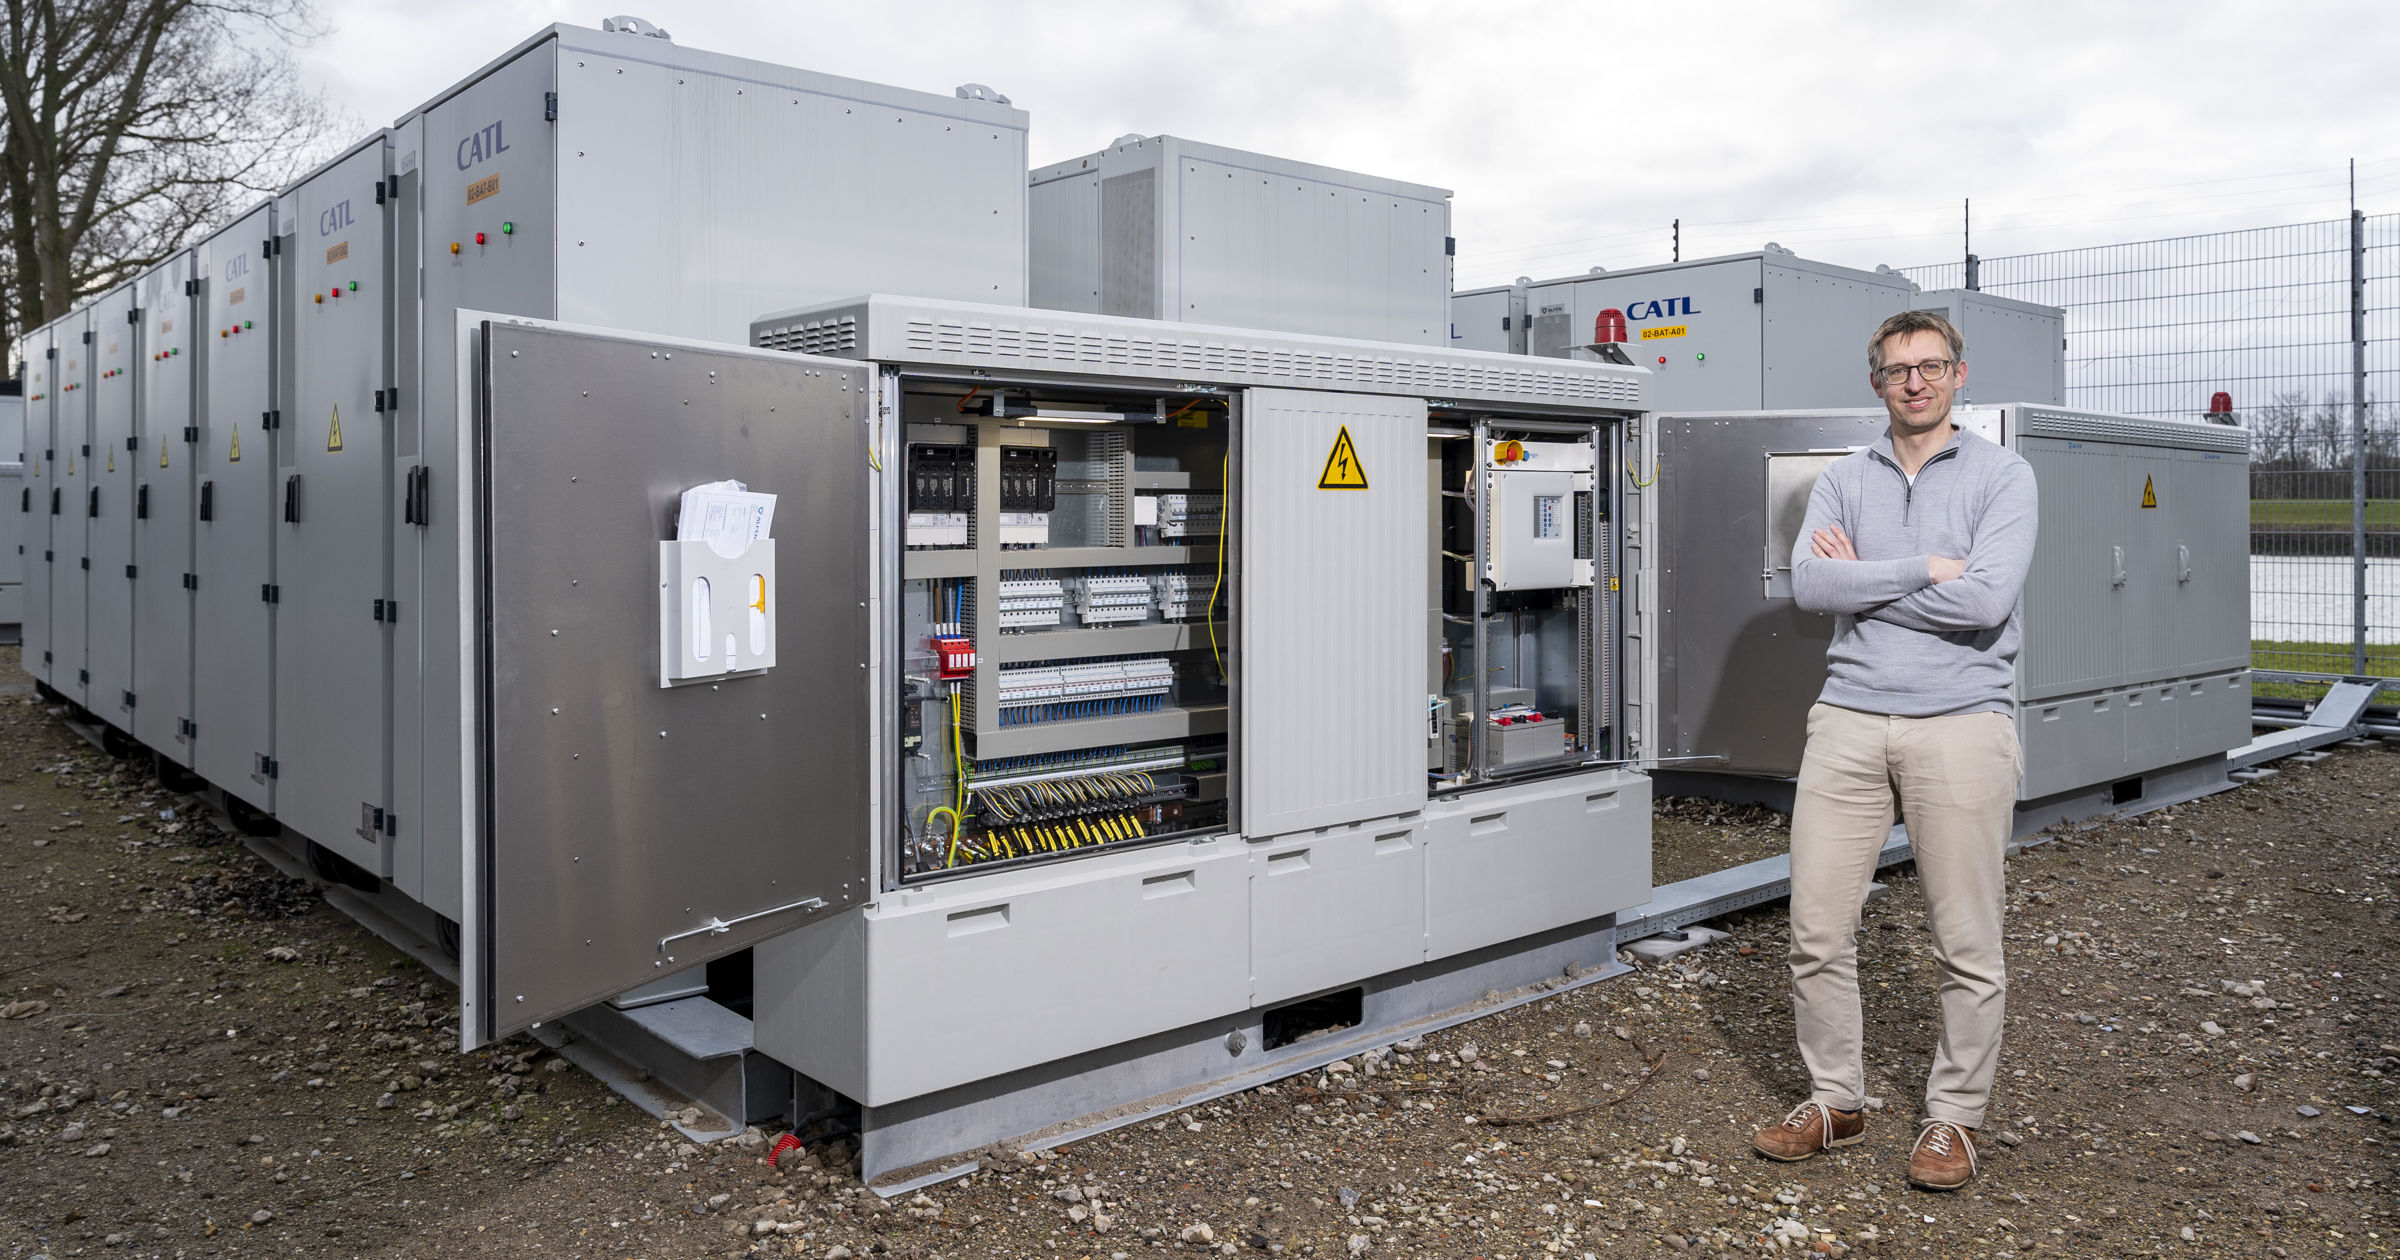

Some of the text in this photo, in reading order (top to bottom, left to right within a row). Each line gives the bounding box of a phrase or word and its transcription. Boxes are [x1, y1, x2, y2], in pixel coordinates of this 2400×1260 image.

[457, 120, 510, 171] CATL
[467, 176, 498, 201] 02-BAT-B01
[320, 199, 355, 237] CATL
[225, 253, 249, 282] CATL
[1627, 296, 1701, 320] CATL
[1643, 328, 1685, 338] 02-BAT-A01
